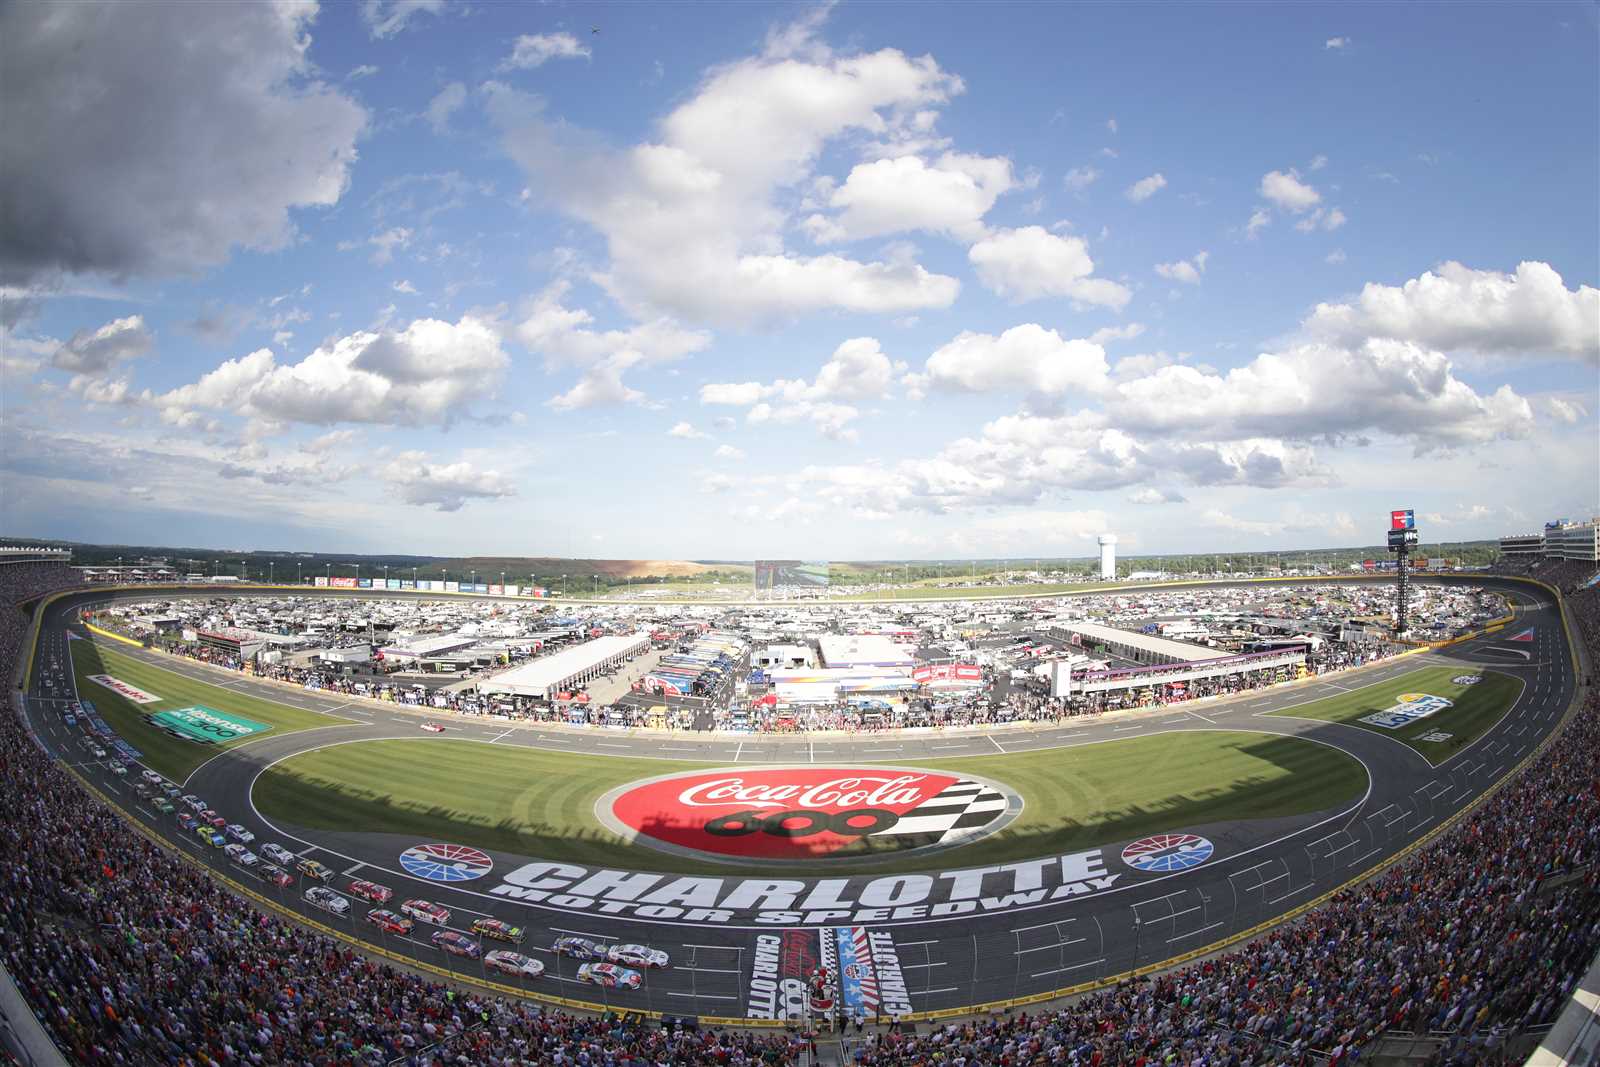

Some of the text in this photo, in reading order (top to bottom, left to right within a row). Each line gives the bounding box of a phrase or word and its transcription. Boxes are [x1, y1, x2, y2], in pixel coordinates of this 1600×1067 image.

[1373, 699, 1451, 727] Lottery
[679, 774, 929, 808] Coca-Cola
[703, 808, 900, 836] 600
[503, 850, 1109, 910] CHARLOTTE
[754, 873, 1122, 924] SPEEDWAY
[489, 884, 735, 922] MOTOR
[747, 934, 782, 1019] CHARLOTTE
[868, 931, 913, 1016] CHARLOTTE
